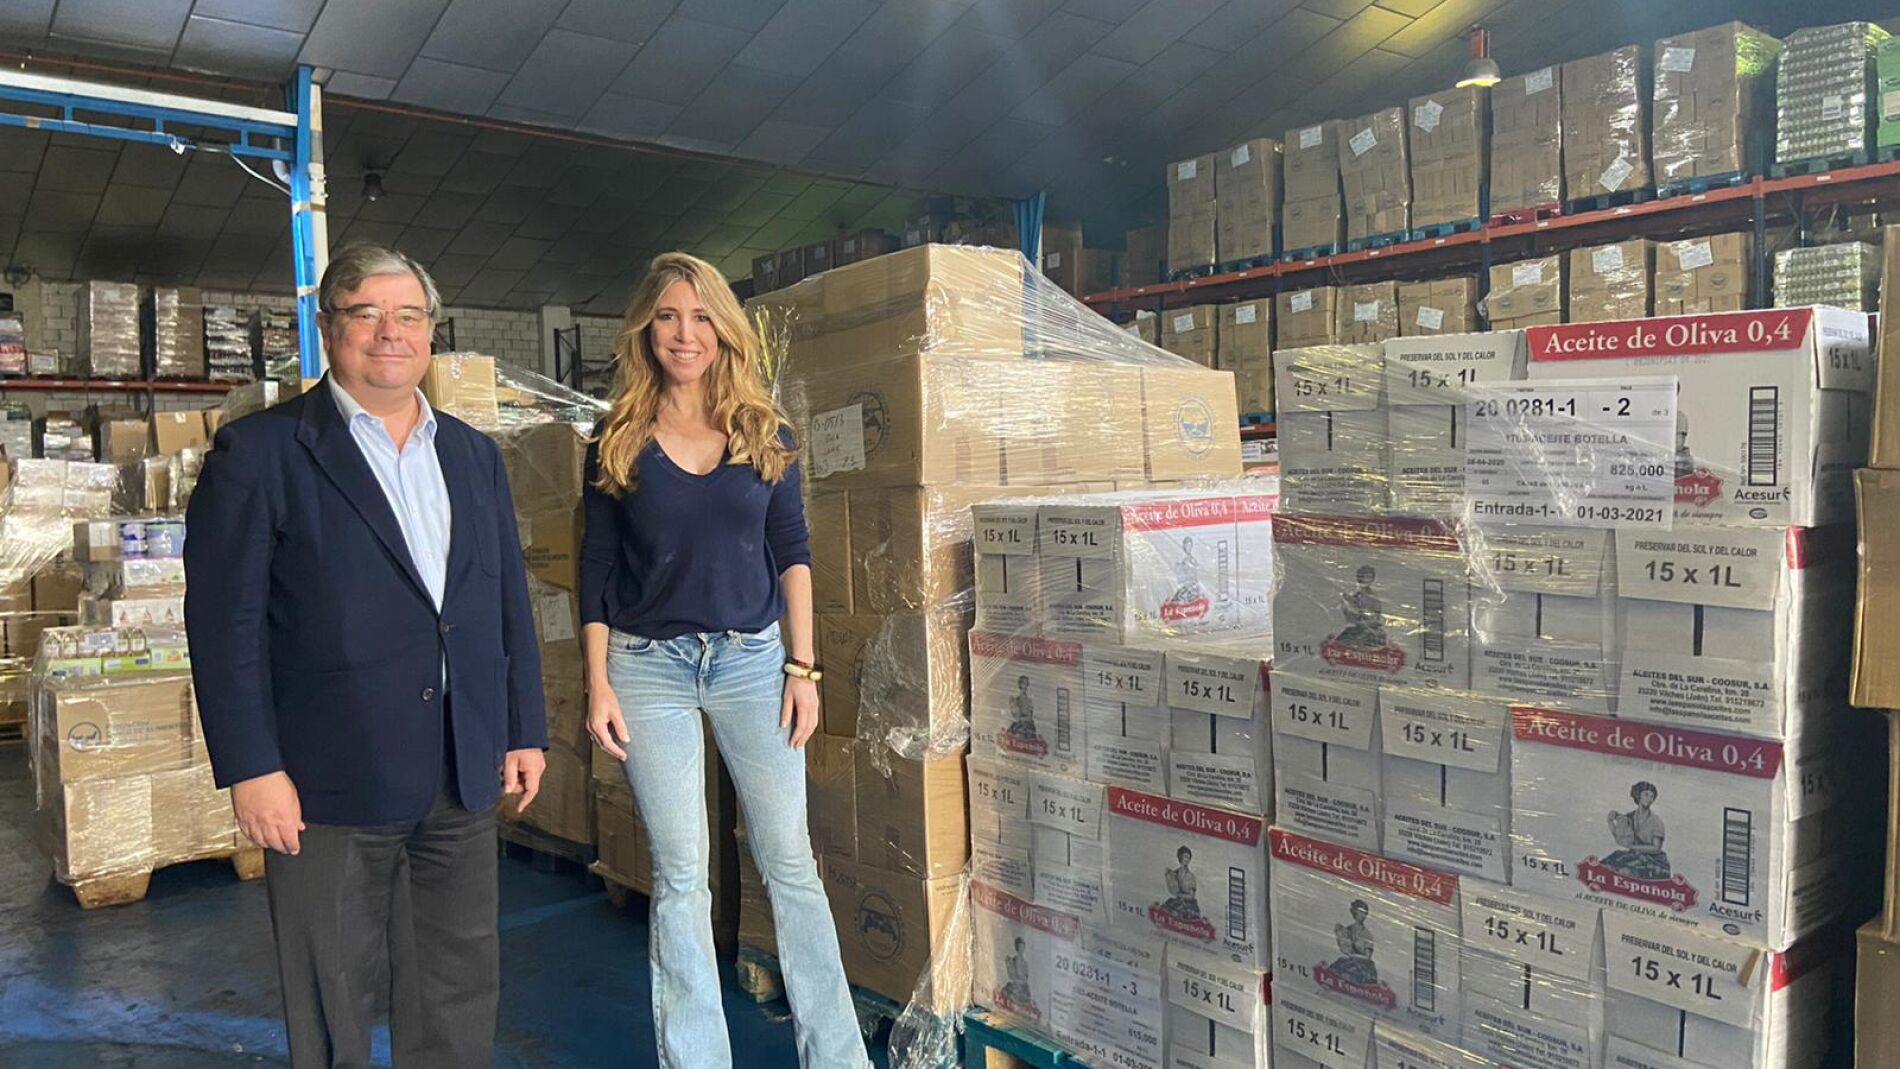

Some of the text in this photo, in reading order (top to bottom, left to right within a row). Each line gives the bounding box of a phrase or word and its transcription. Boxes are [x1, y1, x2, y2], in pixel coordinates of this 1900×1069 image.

[1545, 315, 1792, 354] Aceite de Oliva 0,4
[1475, 350, 1495, 360] CALOR
[1829, 347, 1841, 369] 15
[1843, 354, 1849, 368] x
[1293, 379, 1312, 398] 15
[1318, 382, 1327, 395] x
[1408, 369, 1431, 388] 15
[1437, 373, 1449, 388] x
[1475, 401, 1498, 417] 20
[1506, 398, 1576, 417] 0281-1
[1617, 397, 1631, 416] 2
[1574, 434, 1628, 445] BOTELLA
[1610, 464, 1664, 476] 825,000
[1734, 488, 1781, 500] Acesur
[1166, 506, 1178, 519] de
[1181, 503, 1209, 518] Oliva
[1577, 506, 1663, 523] 01-03-2021
[983, 529, 1021, 543] 15 x 1L
[1053, 530, 1098, 546] 15 x 1L
[1634, 541, 1676, 553] PRESERVAR
[1678, 544, 1692, 554] DEL
[1693, 545, 1707, 554] SOL
[1715, 546, 1730, 556] DEL
[1731, 547, 1757, 557] CALOR
[1493, 553, 1571, 576] 15 x 1L
[1645, 560, 1742, 588] 15 x 1L
[1280, 642, 1291, 652] 15
[1098, 671, 1143, 691] 15 x 1L
[1633, 668, 1666, 681] ACEITES
[1668, 672, 1684, 682] DEL
[1686, 675, 1704, 684] SUR
[1183, 680, 1236, 702] 15 x 1L
[1288, 703, 1350, 731] 15 x 1L
[1402, 723, 1475, 752] 15 x 1L
[1528, 718, 1765, 770] Aceite de Oliva 0,4
[977, 782, 1014, 804] 15 x 1L
[1042, 799, 1085, 823] 15 x 1L
[1117, 794, 1250, 839] Aceite de Oliva 0,4
[1278, 837, 1441, 898] Aceite de Oliva 0,4
[1521, 855, 1570, 878] 15 x 1L
[1586, 869, 1605, 884] La
[1119, 901, 1126, 910] 15
[1583, 894, 1614, 910] ACEITE
[1616, 900, 1629, 912] DE
[1630, 903, 1656, 919] OLIVA
[1708, 901, 1755, 922] Acesur
[1553, 916, 1576, 929] CALOR
[1485, 916, 1563, 955] 15 x 1L
[1621, 933, 1660, 952] PRESERVAR
[1662, 944, 1674, 956] DEL
[1676, 948, 1690, 961] SOL
[1697, 954, 1711, 967] DEL
[1712, 959, 1736, 973] CALOR
[1056, 955, 1069, 971] 20
[1130, 981, 1138, 996] 3
[1276, 957, 1309, 977] 15 x 1L
[1632, 956, 1722, 1000] 15 x 1L
[1183, 979, 1235, 1012] 15 x 1L
[1056, 1030, 1106, 1056] Entrada-1-1
[1288, 1018, 1344, 1056] 15 x 1L
